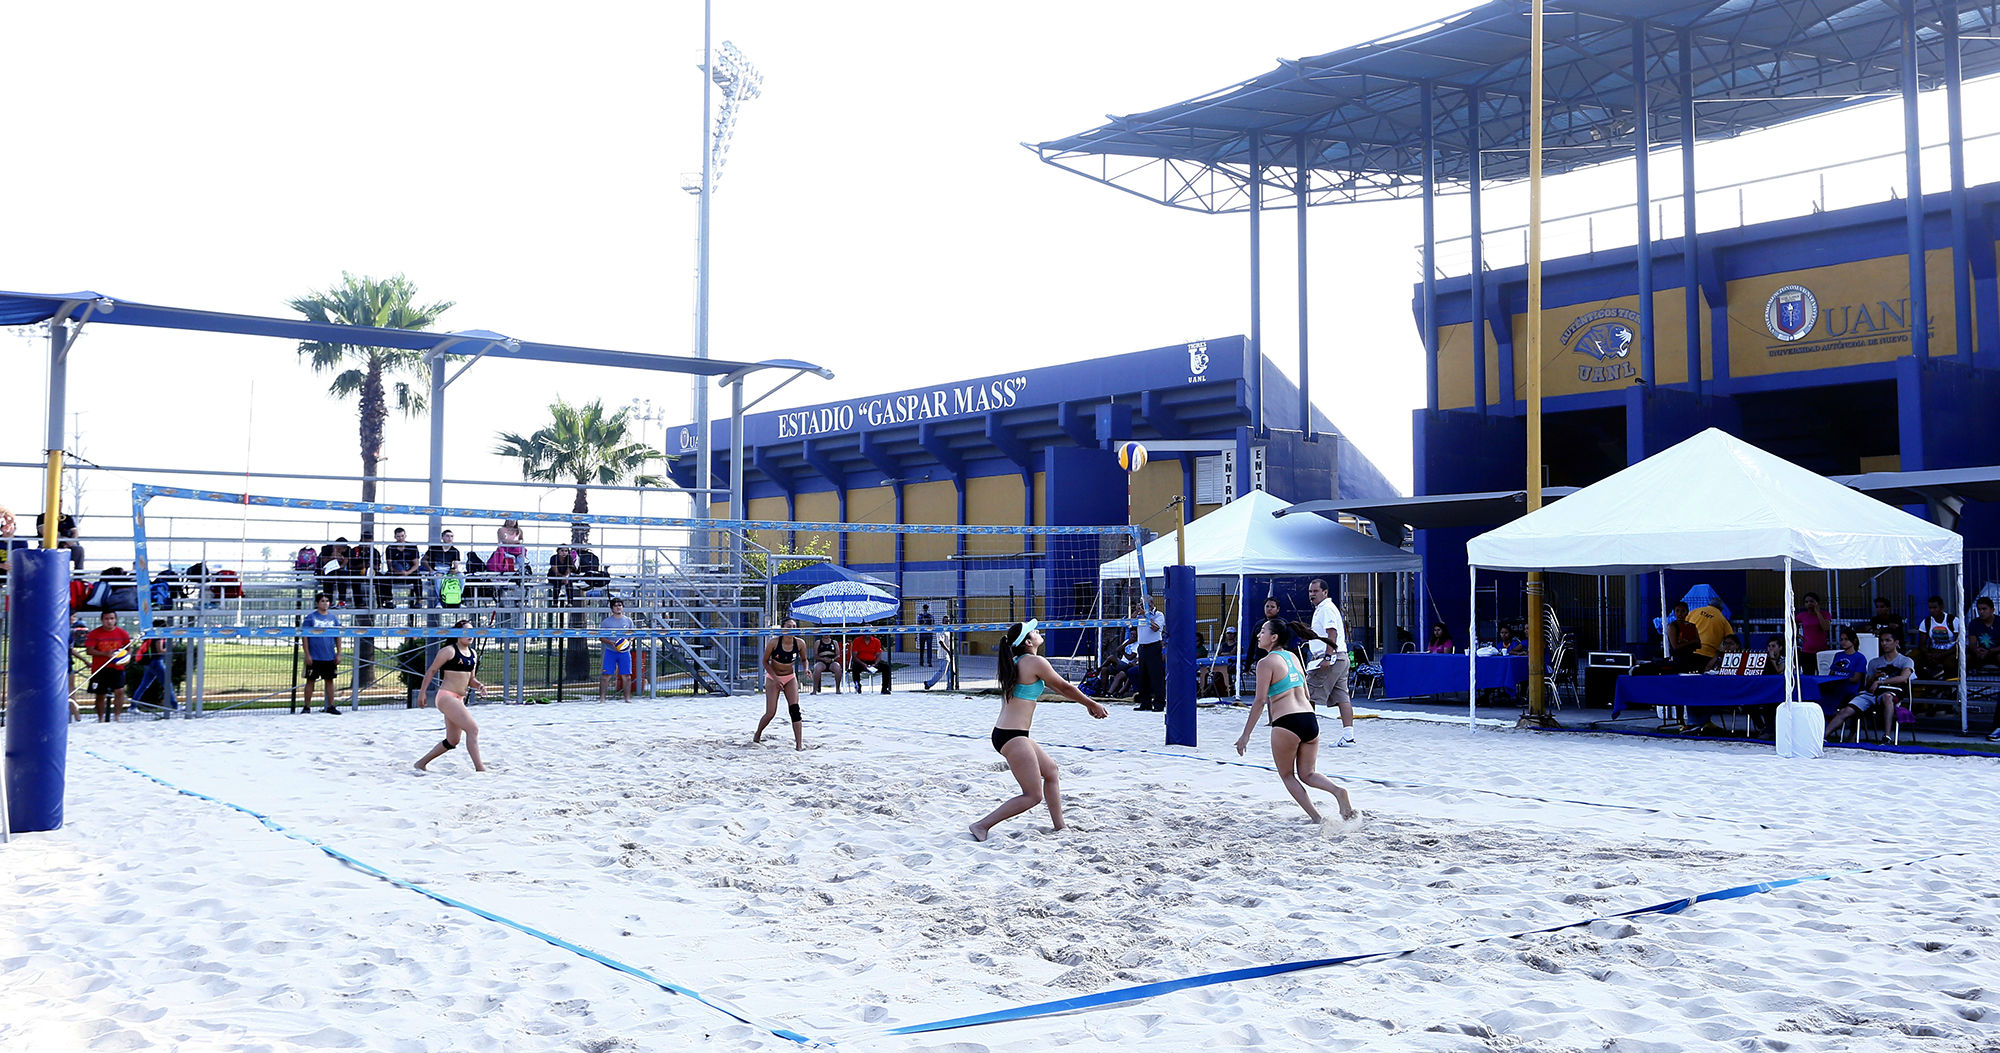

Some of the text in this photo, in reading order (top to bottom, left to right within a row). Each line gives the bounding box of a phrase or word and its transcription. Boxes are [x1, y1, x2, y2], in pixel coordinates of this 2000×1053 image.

[1868, 338, 1879, 346] DE
[1880, 335, 1909, 344] NUEVO
[1578, 361, 1636, 382] UANL
[778, 405, 854, 438] ESTADIO
[1723, 656, 1765, 667] 10 18
